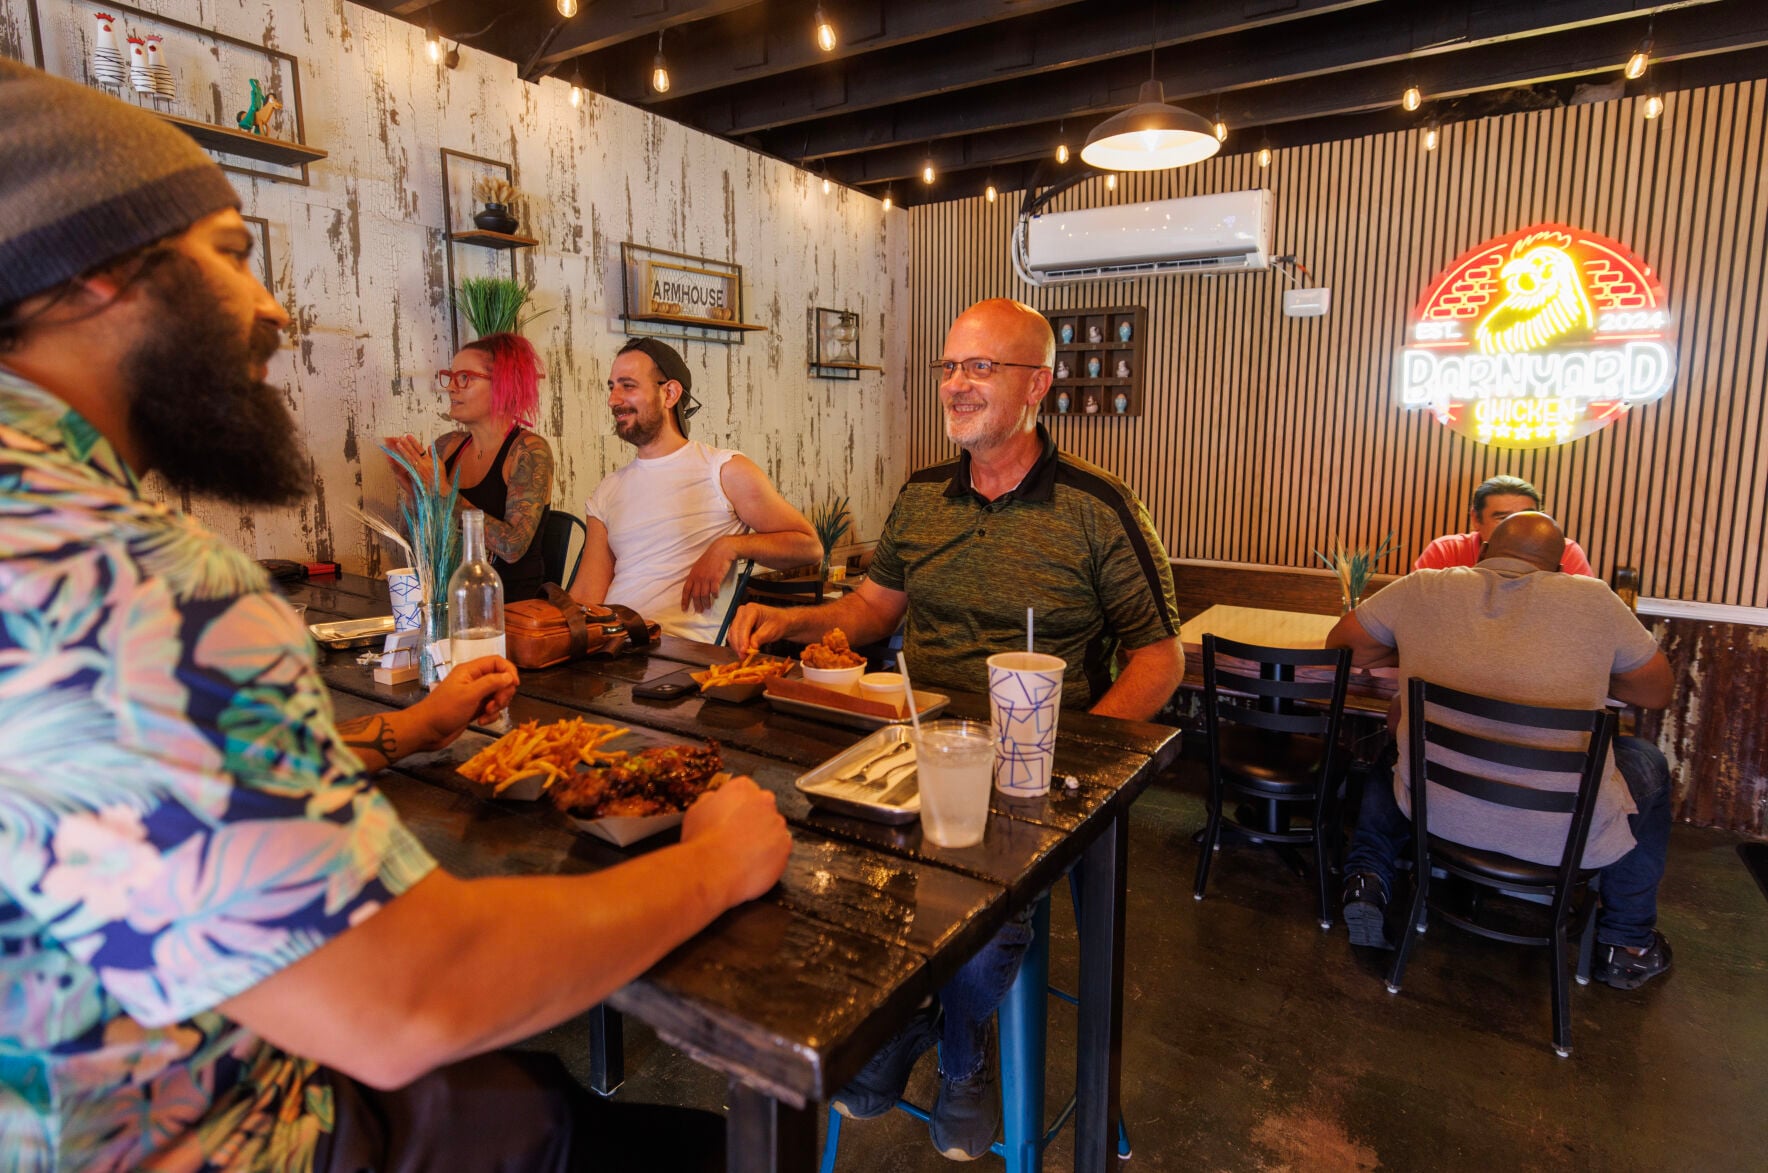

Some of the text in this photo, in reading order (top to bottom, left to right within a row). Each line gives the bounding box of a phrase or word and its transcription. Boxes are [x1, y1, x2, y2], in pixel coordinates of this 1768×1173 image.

[652, 280, 723, 307] ARMHOUSE
[1415, 312, 1664, 340] EST. 2024
[1475, 398, 1576, 422] CHICKEN
